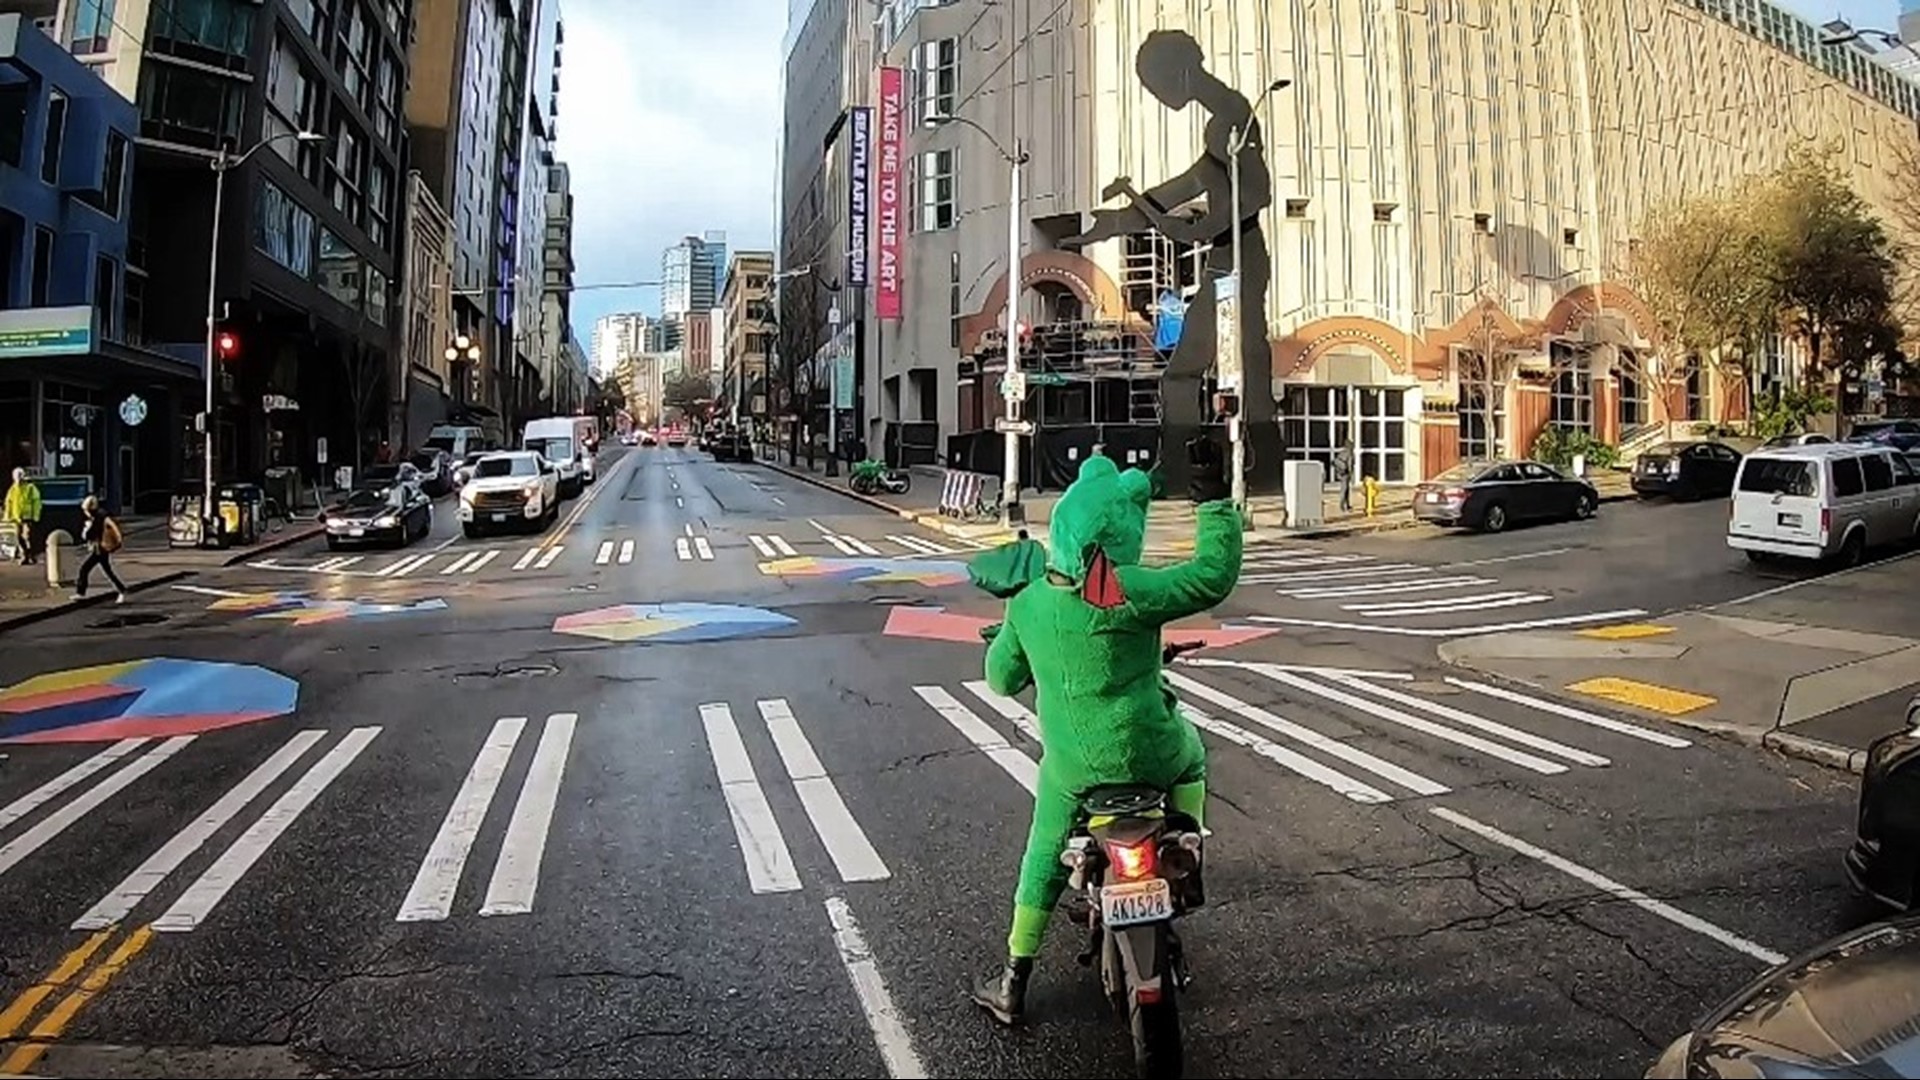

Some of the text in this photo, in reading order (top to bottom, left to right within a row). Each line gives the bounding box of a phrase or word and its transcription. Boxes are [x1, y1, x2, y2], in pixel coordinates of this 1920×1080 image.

[851, 111, 867, 282] SEATTLE ART MUSEUM
[881, 94, 898, 292] TAKE ME TO THE ART
[60, 453, 74, 468] UP
